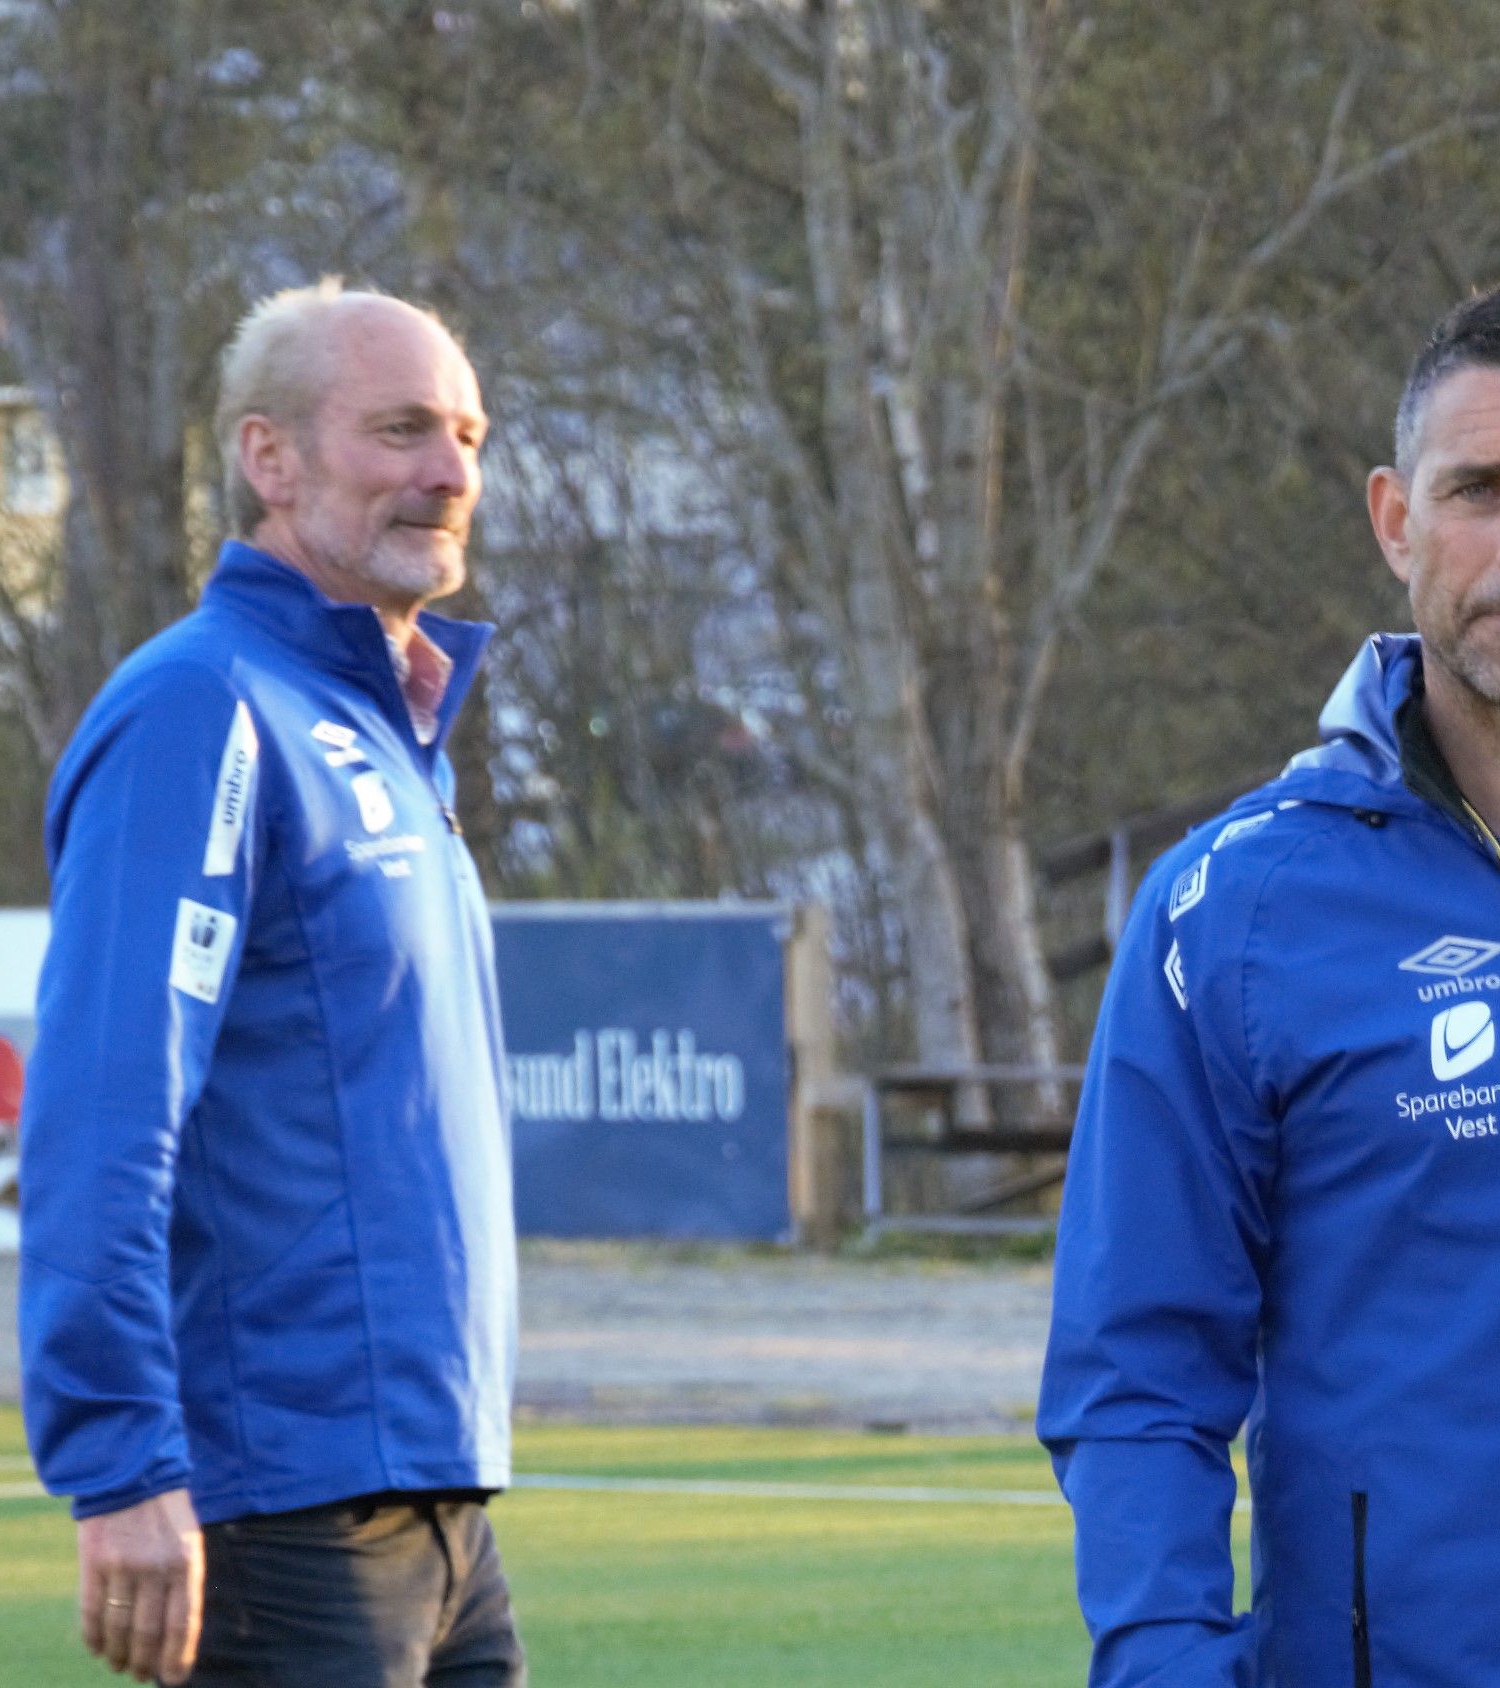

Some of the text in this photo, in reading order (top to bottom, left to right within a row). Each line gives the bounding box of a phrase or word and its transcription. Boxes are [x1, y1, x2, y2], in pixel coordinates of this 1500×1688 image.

[224, 750, 247, 825] umbro
[1417, 974, 1500, 1003] umbro
[597, 1027, 745, 1124] Elektro
[1445, 1113, 1498, 1140] Vest
